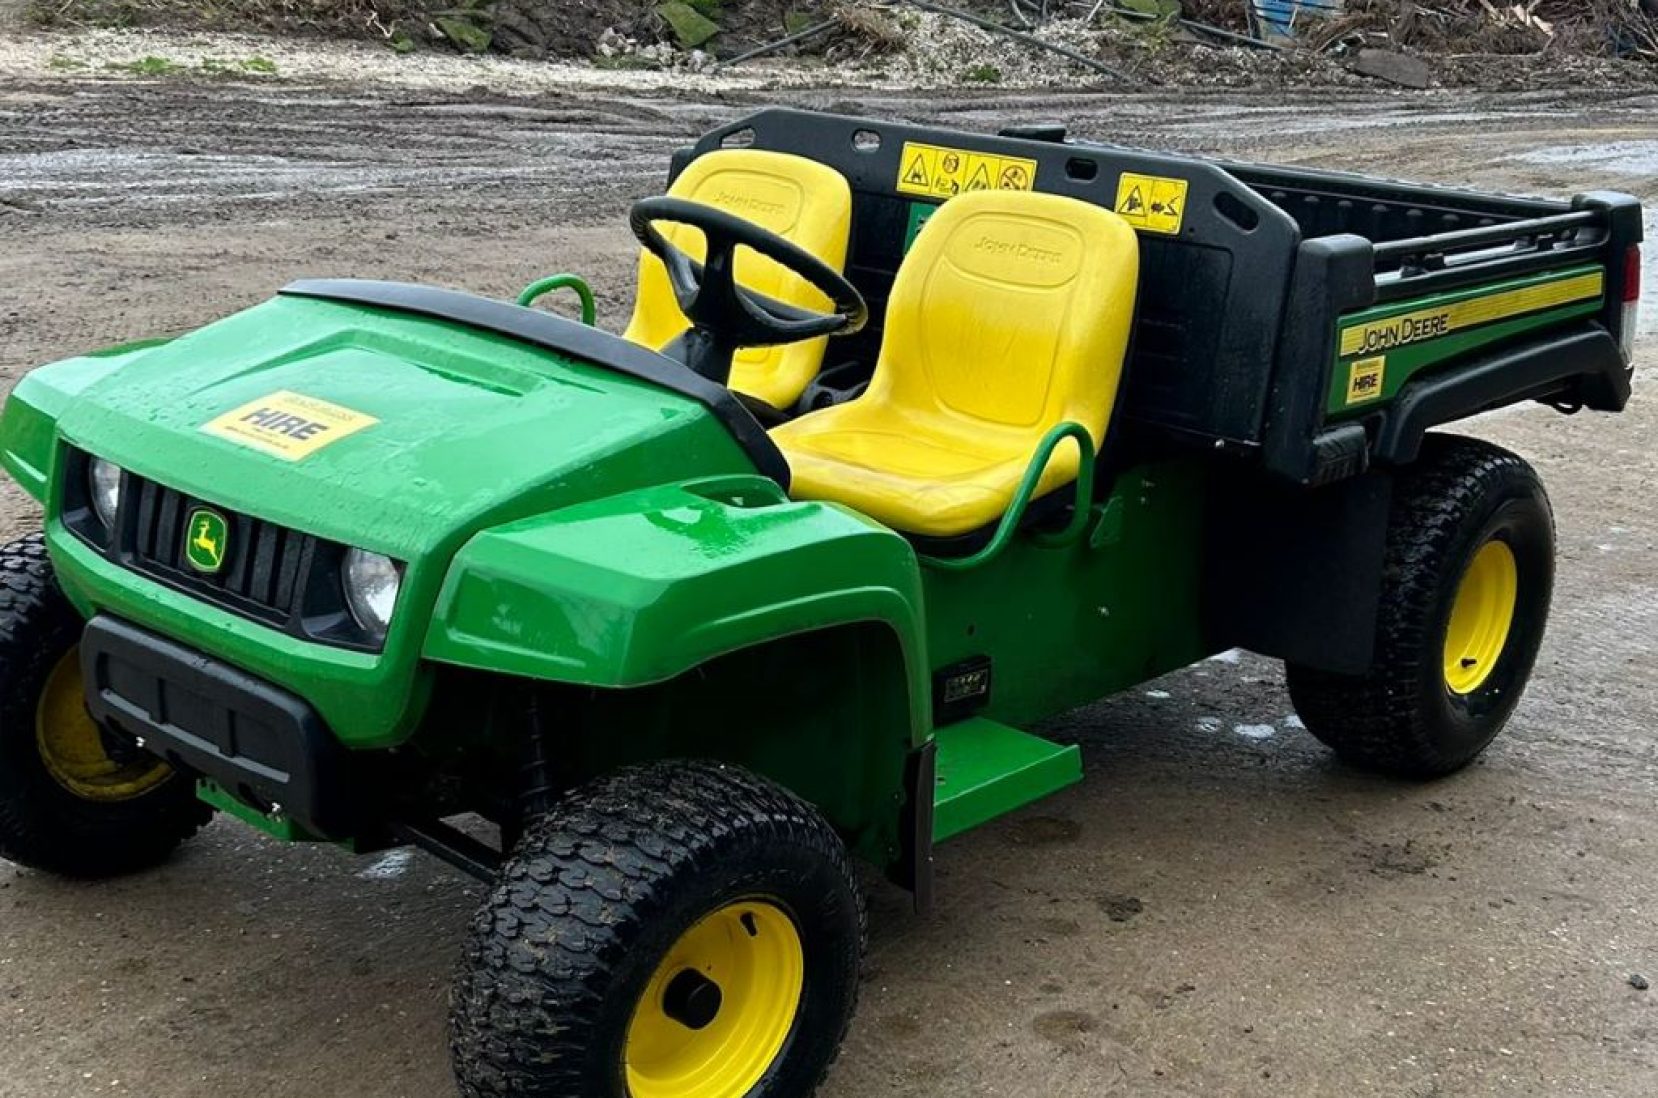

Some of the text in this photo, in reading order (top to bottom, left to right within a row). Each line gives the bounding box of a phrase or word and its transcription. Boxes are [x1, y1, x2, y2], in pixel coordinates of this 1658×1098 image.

[1359, 314, 1449, 352] JOHN DEERE
[1352, 374, 1378, 392] HIRE
[239, 407, 330, 440] HIRE
